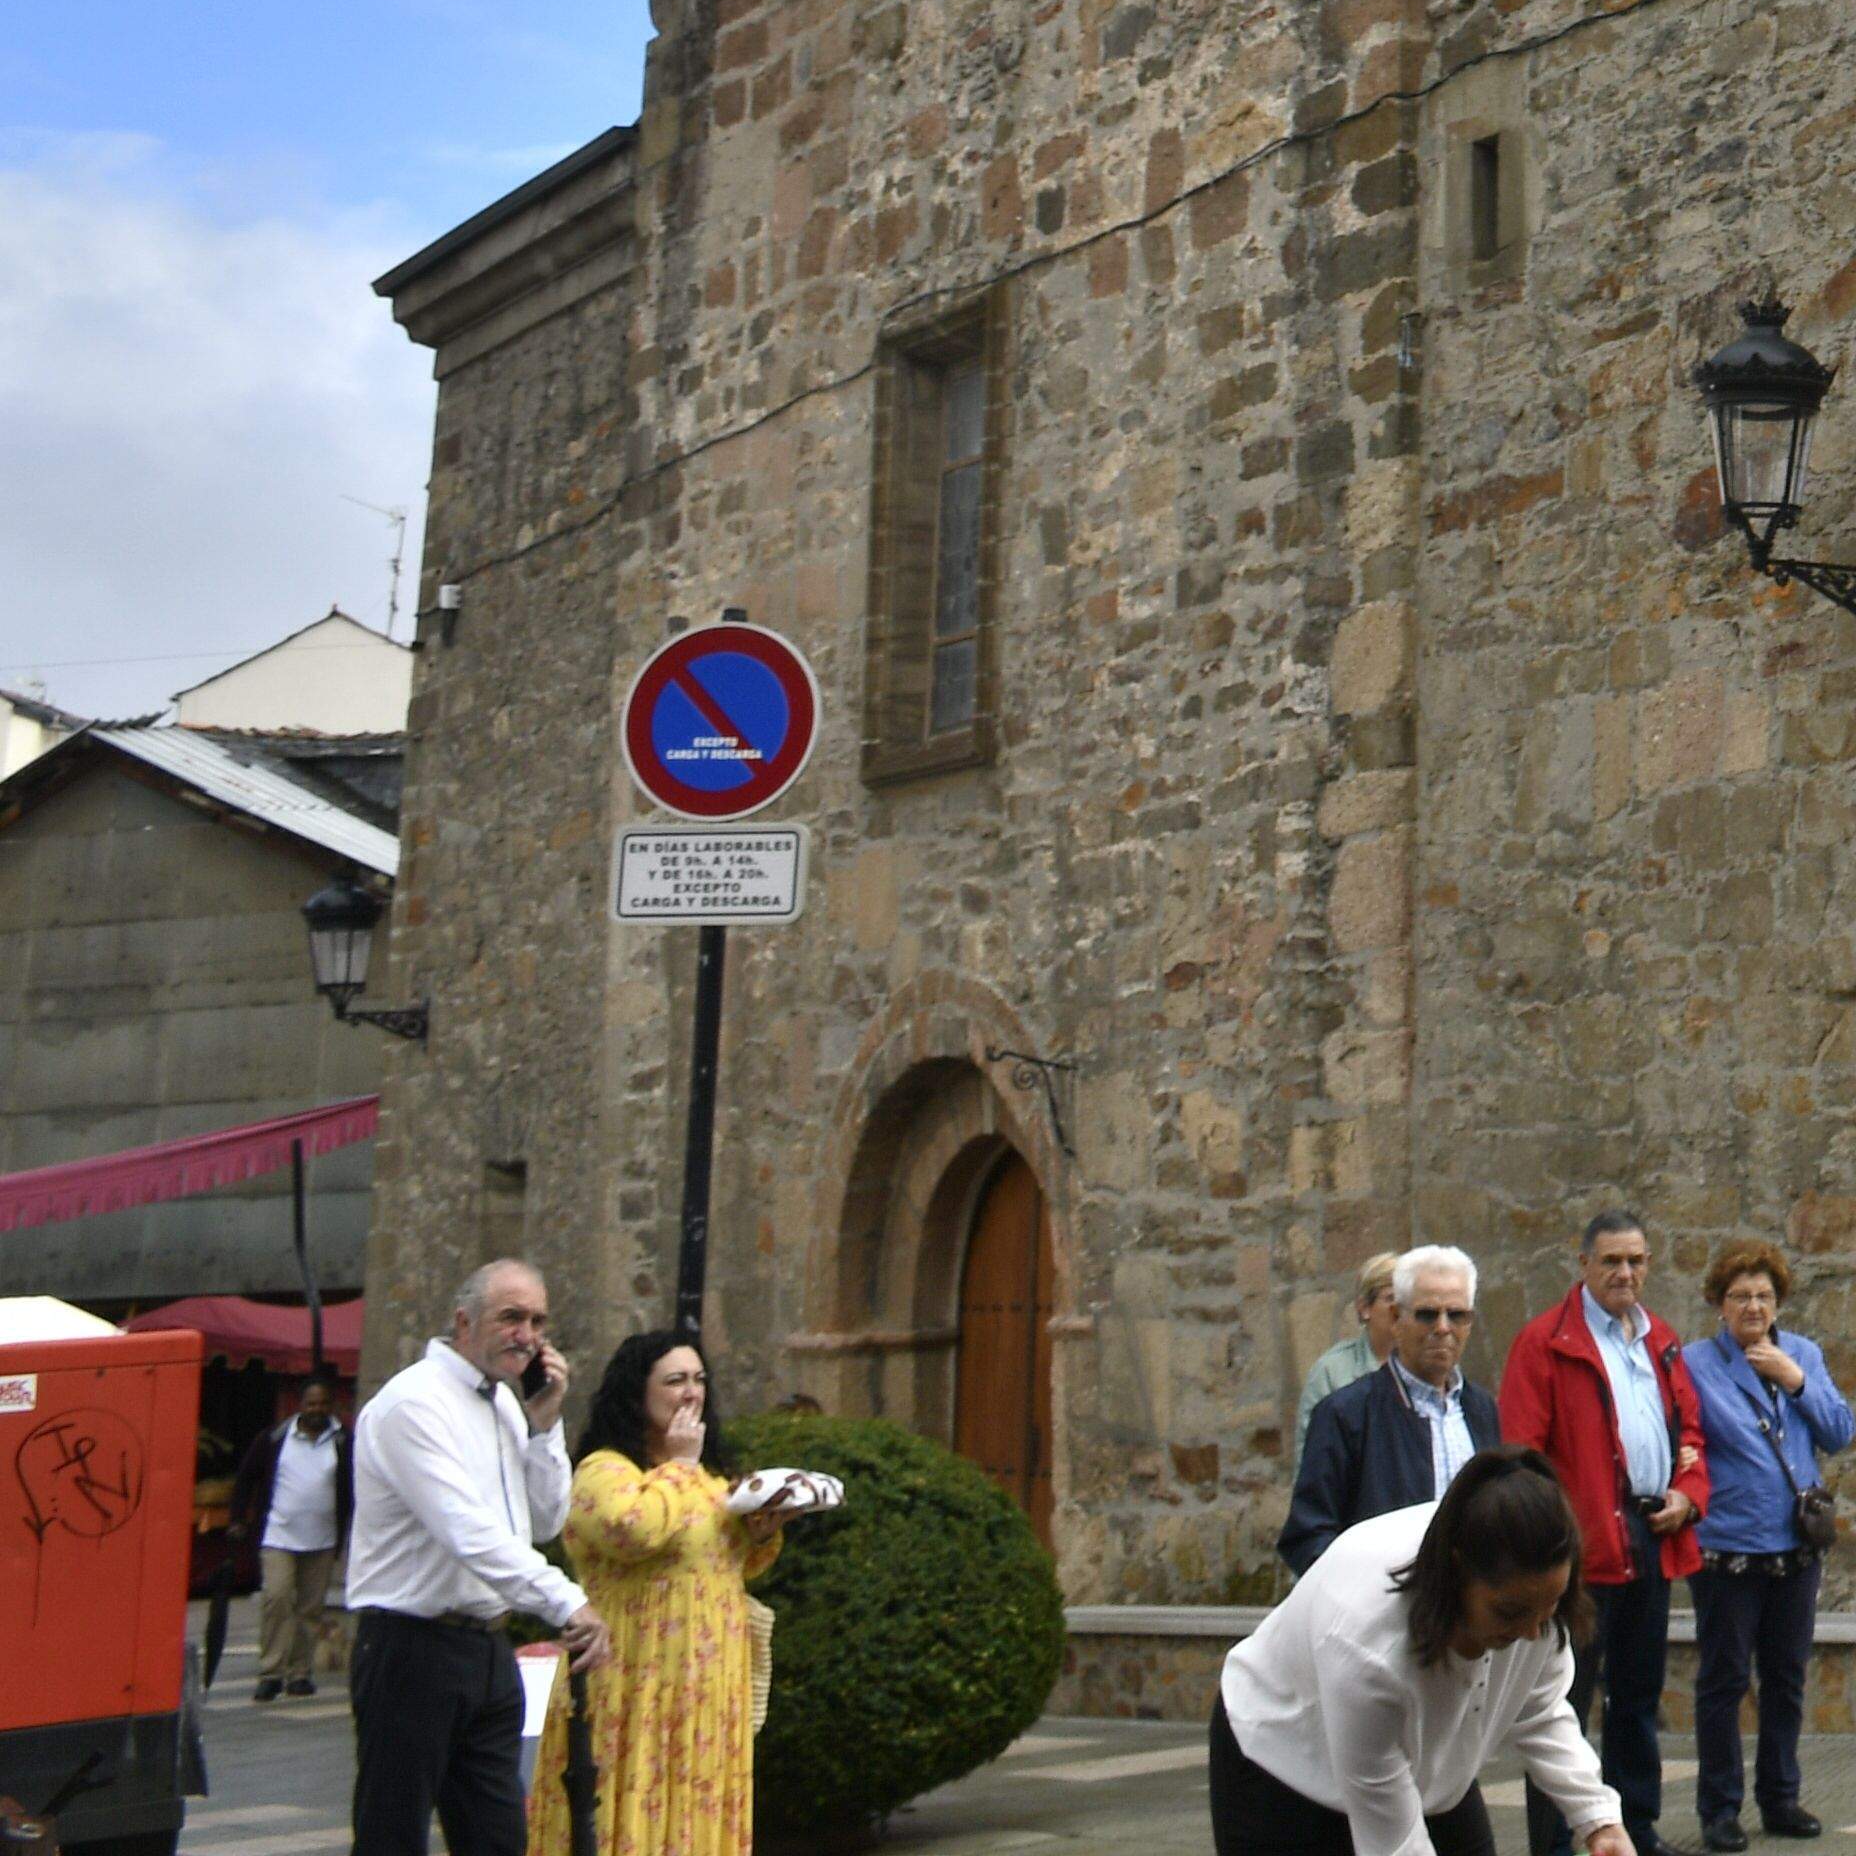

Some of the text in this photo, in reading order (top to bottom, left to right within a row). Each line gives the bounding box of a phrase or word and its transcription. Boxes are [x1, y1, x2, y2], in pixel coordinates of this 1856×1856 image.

[629, 841, 792, 853] EN DÍAS LABORABLES
[661, 856, 679, 866] DE
[713, 856, 722, 865] A
[648, 870, 657, 880] Y
[663, 870, 681, 880] DE
[723, 870, 732, 879] A
[673, 883, 741, 893] EXCEPTO
[631, 896, 781, 907] CARGA Y DESCARGA
